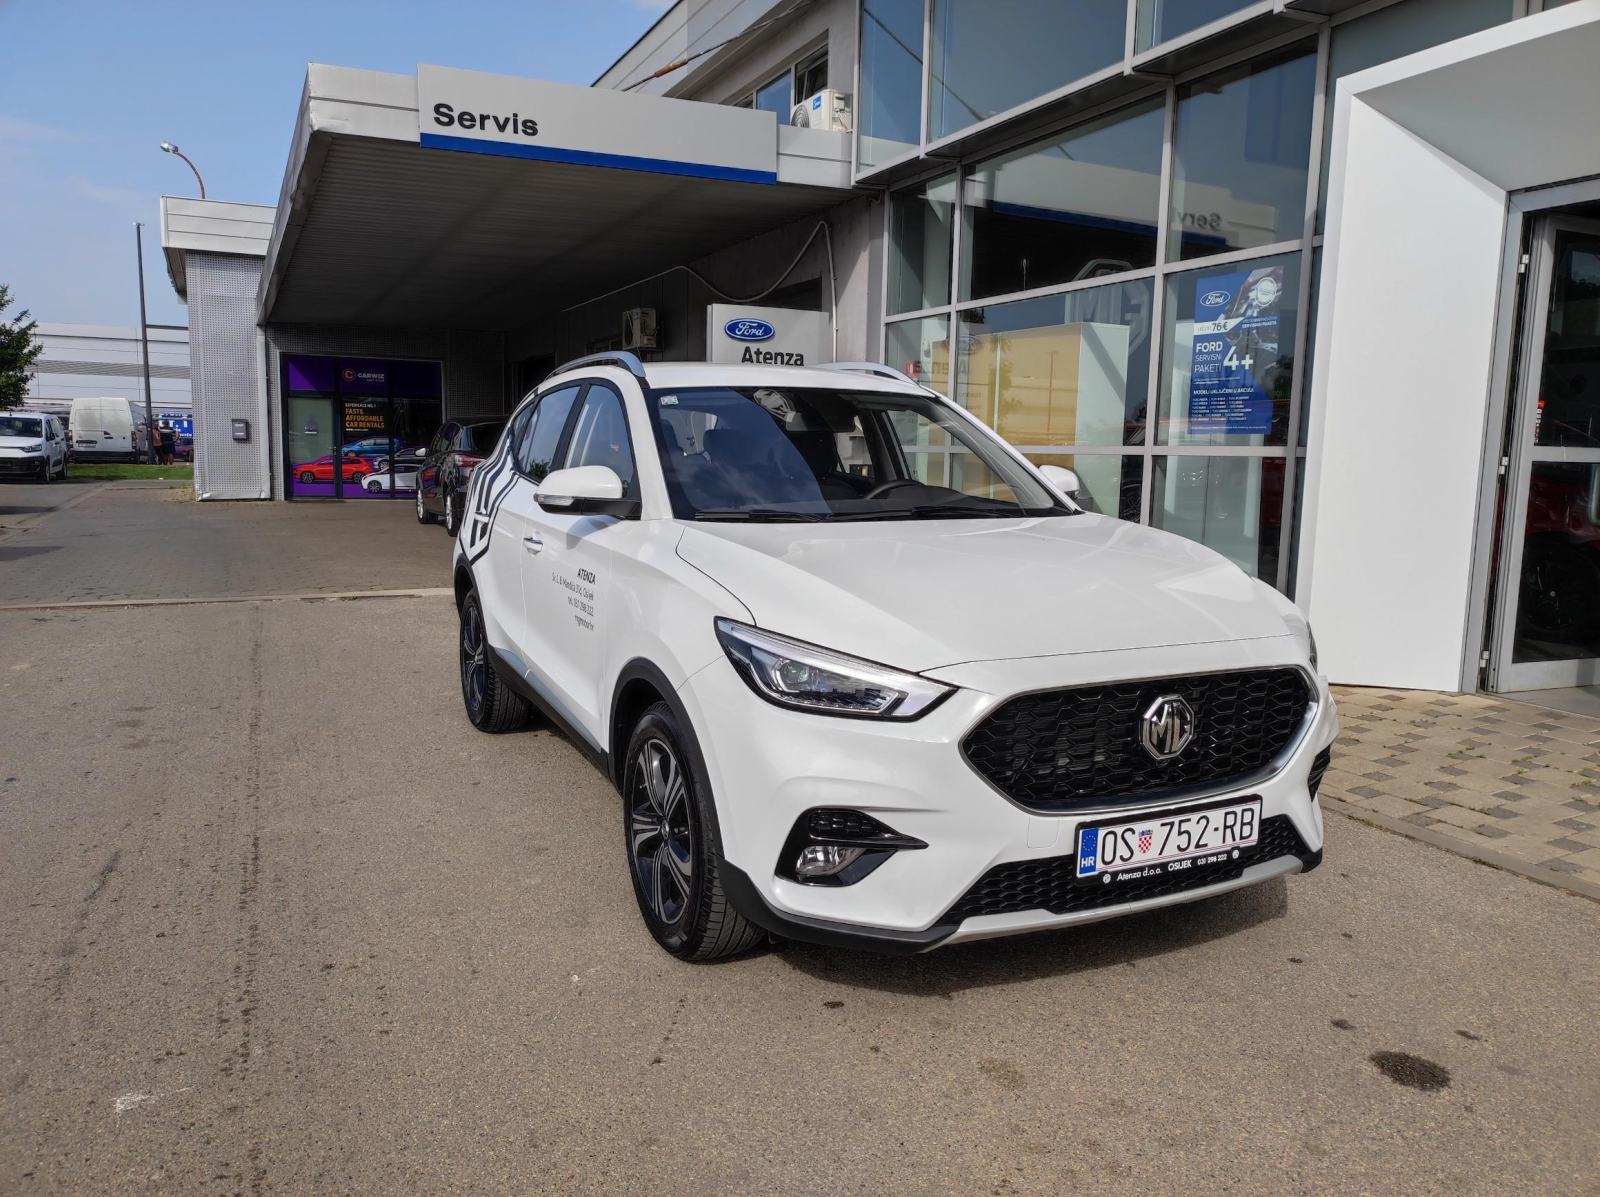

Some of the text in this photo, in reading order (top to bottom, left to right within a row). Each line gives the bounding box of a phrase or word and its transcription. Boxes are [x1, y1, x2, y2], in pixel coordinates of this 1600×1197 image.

[433, 103, 539, 137] Servis
[734, 320, 766, 337] Ford
[741, 346, 804, 367] Atenza
[1196, 341, 1223, 353] FORD
[1223, 346, 1253, 370] 4+
[577, 568, 595, 584] ATENZA
[1148, 700, 1191, 755] MG
[1101, 827, 1136, 866] OS
[1081, 856, 1095, 869] HR
[1117, 870, 1142, 882] Atenza
[1168, 859, 1193, 872] OSIJEK
